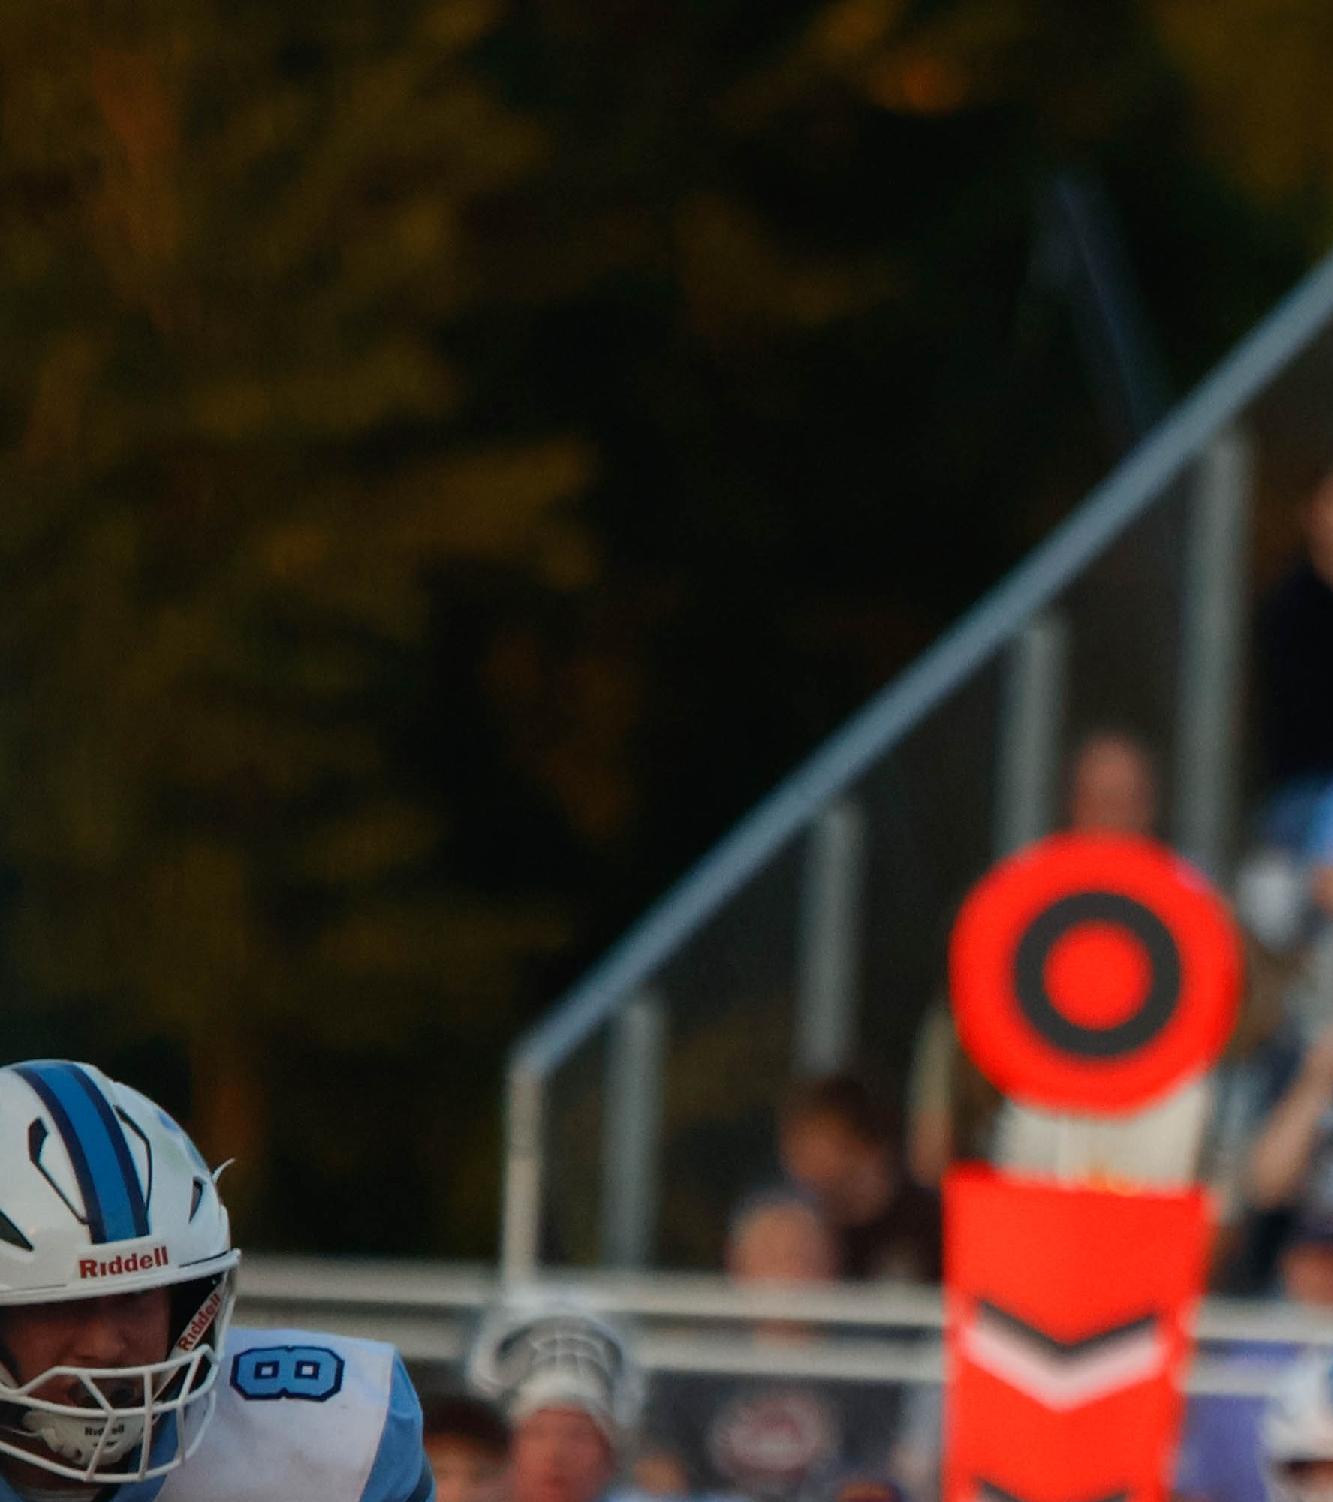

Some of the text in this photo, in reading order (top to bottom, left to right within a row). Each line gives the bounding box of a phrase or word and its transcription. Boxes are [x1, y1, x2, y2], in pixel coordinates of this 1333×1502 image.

[78, 1246, 169, 1279] Riddell
[178, 1293, 221, 1350] Riddell
[230, 1345, 345, 1402] 8
[84, 1424, 124, 1437] Ridell
